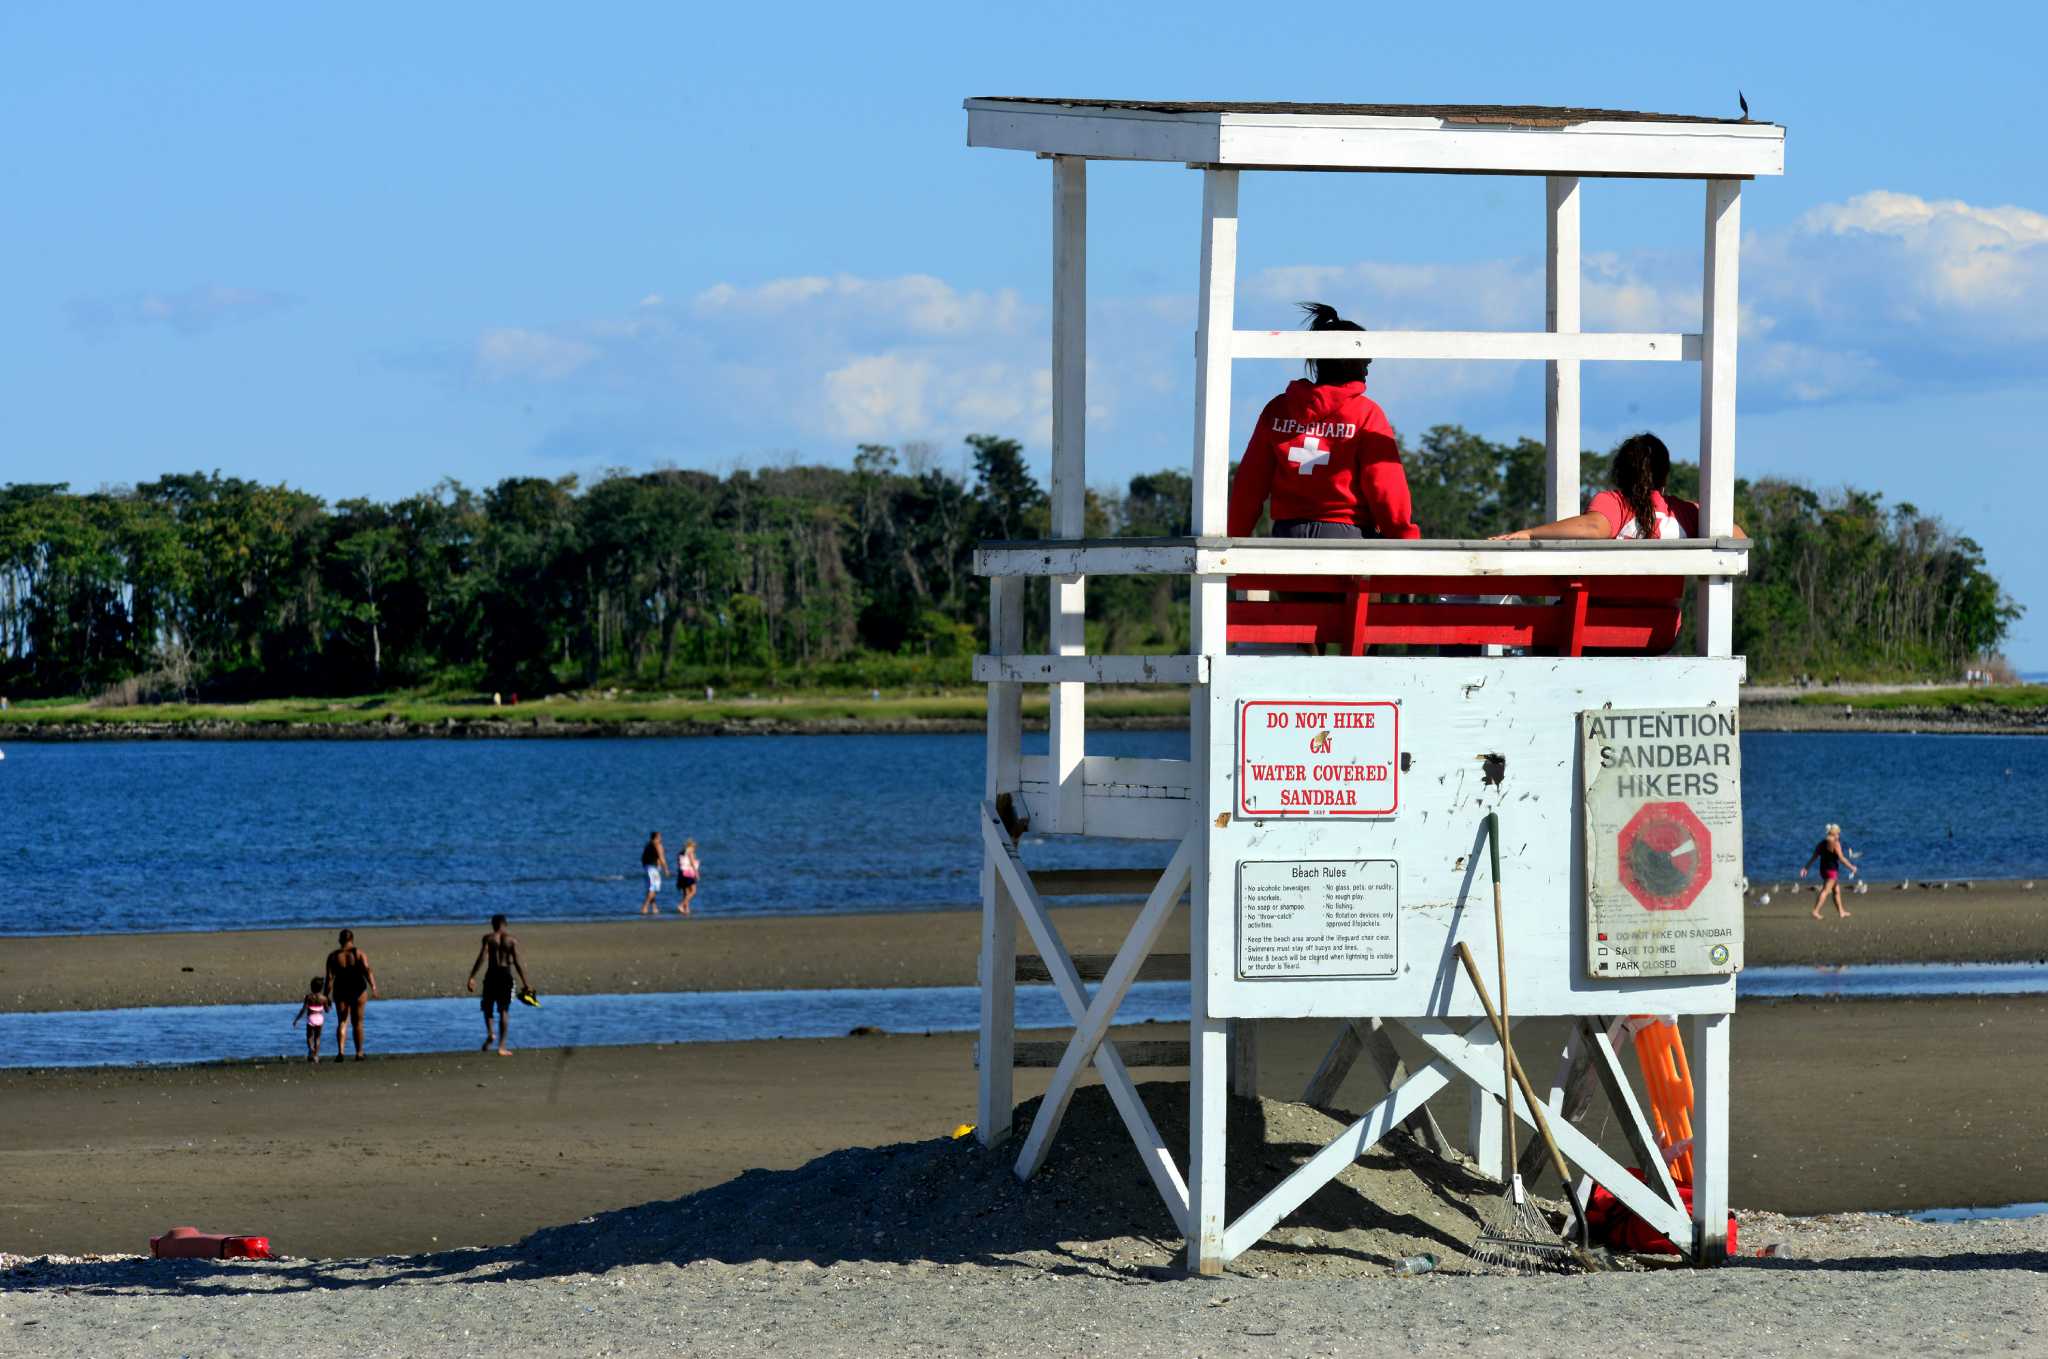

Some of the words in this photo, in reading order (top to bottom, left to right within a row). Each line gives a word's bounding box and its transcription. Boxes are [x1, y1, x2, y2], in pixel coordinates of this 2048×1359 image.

[1272, 418, 1356, 438] LIFEGUARD
[1267, 712, 1289, 728] DO
[1295, 712, 1327, 728] NOT
[1333, 712, 1375, 728] HIKE
[1589, 714, 1736, 739] ATTENTION
[1310, 737, 1332, 754] ON
[1600, 743, 1731, 769] SANDBAR
[1251, 765, 1306, 781] WATER
[1313, 765, 1388, 781] COVERED
[1617, 772, 1719, 798] HIKERS
[1280, 790, 1357, 806] SANDBAR
[1292, 867, 1319, 878] Beach
[1322, 866, 1347, 878] Rules
[1652, 930, 1672, 939] HIKE
[1674, 929, 1688, 938] ON
[1689, 928, 1732, 938] SANDBAR
[1643, 946, 1655, 955] TO
[1616, 961, 1640, 970] PARK
[1642, 960, 1677, 970] CLOSED
